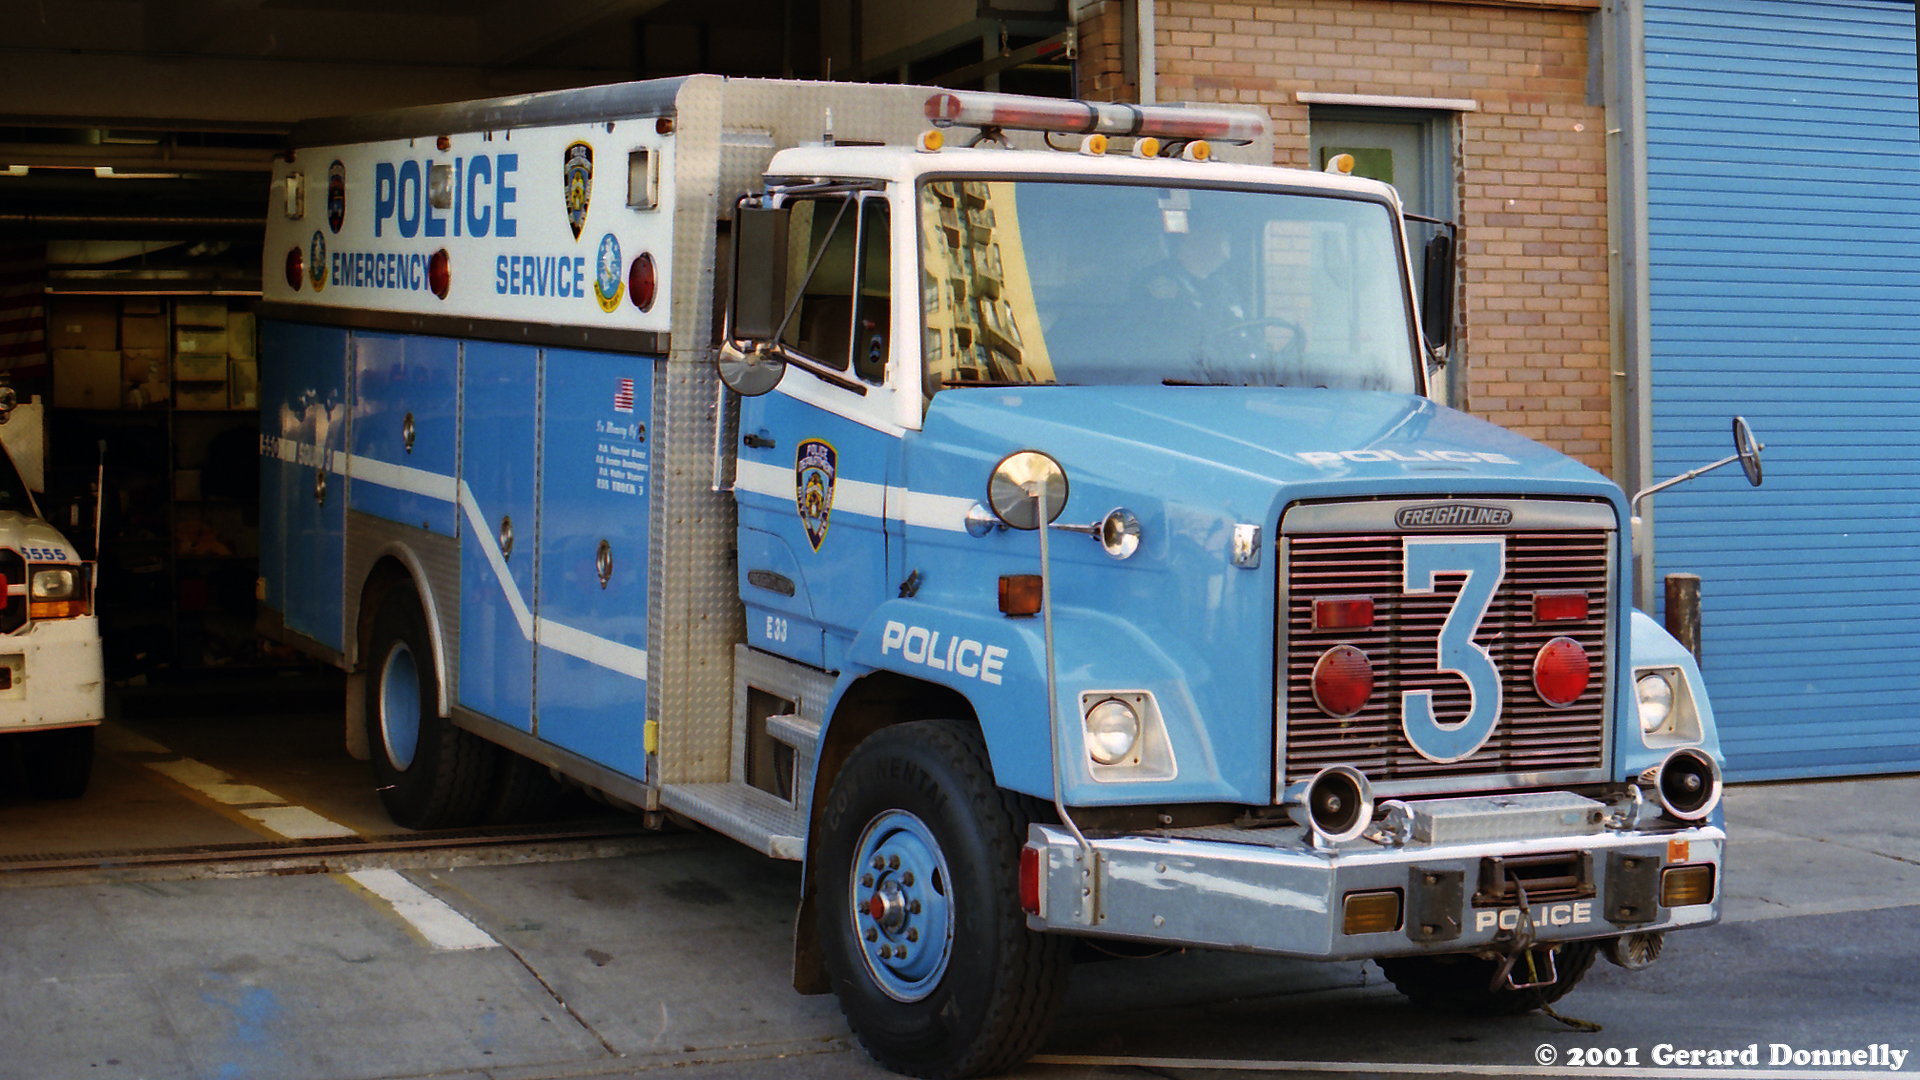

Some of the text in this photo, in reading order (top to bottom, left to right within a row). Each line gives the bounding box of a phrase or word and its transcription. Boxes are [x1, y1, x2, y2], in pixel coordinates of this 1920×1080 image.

[374, 154, 519, 239] POLICE
[332, 251, 432, 291] EMERGENCY
[495, 255, 586, 298] SERVICE
[1296, 450, 1520, 470] POLICE
[1401, 505, 1511, 525] FREIGHTLINER
[881, 620, 1009, 686] POLICE
[1401, 535, 1506, 764] 3
